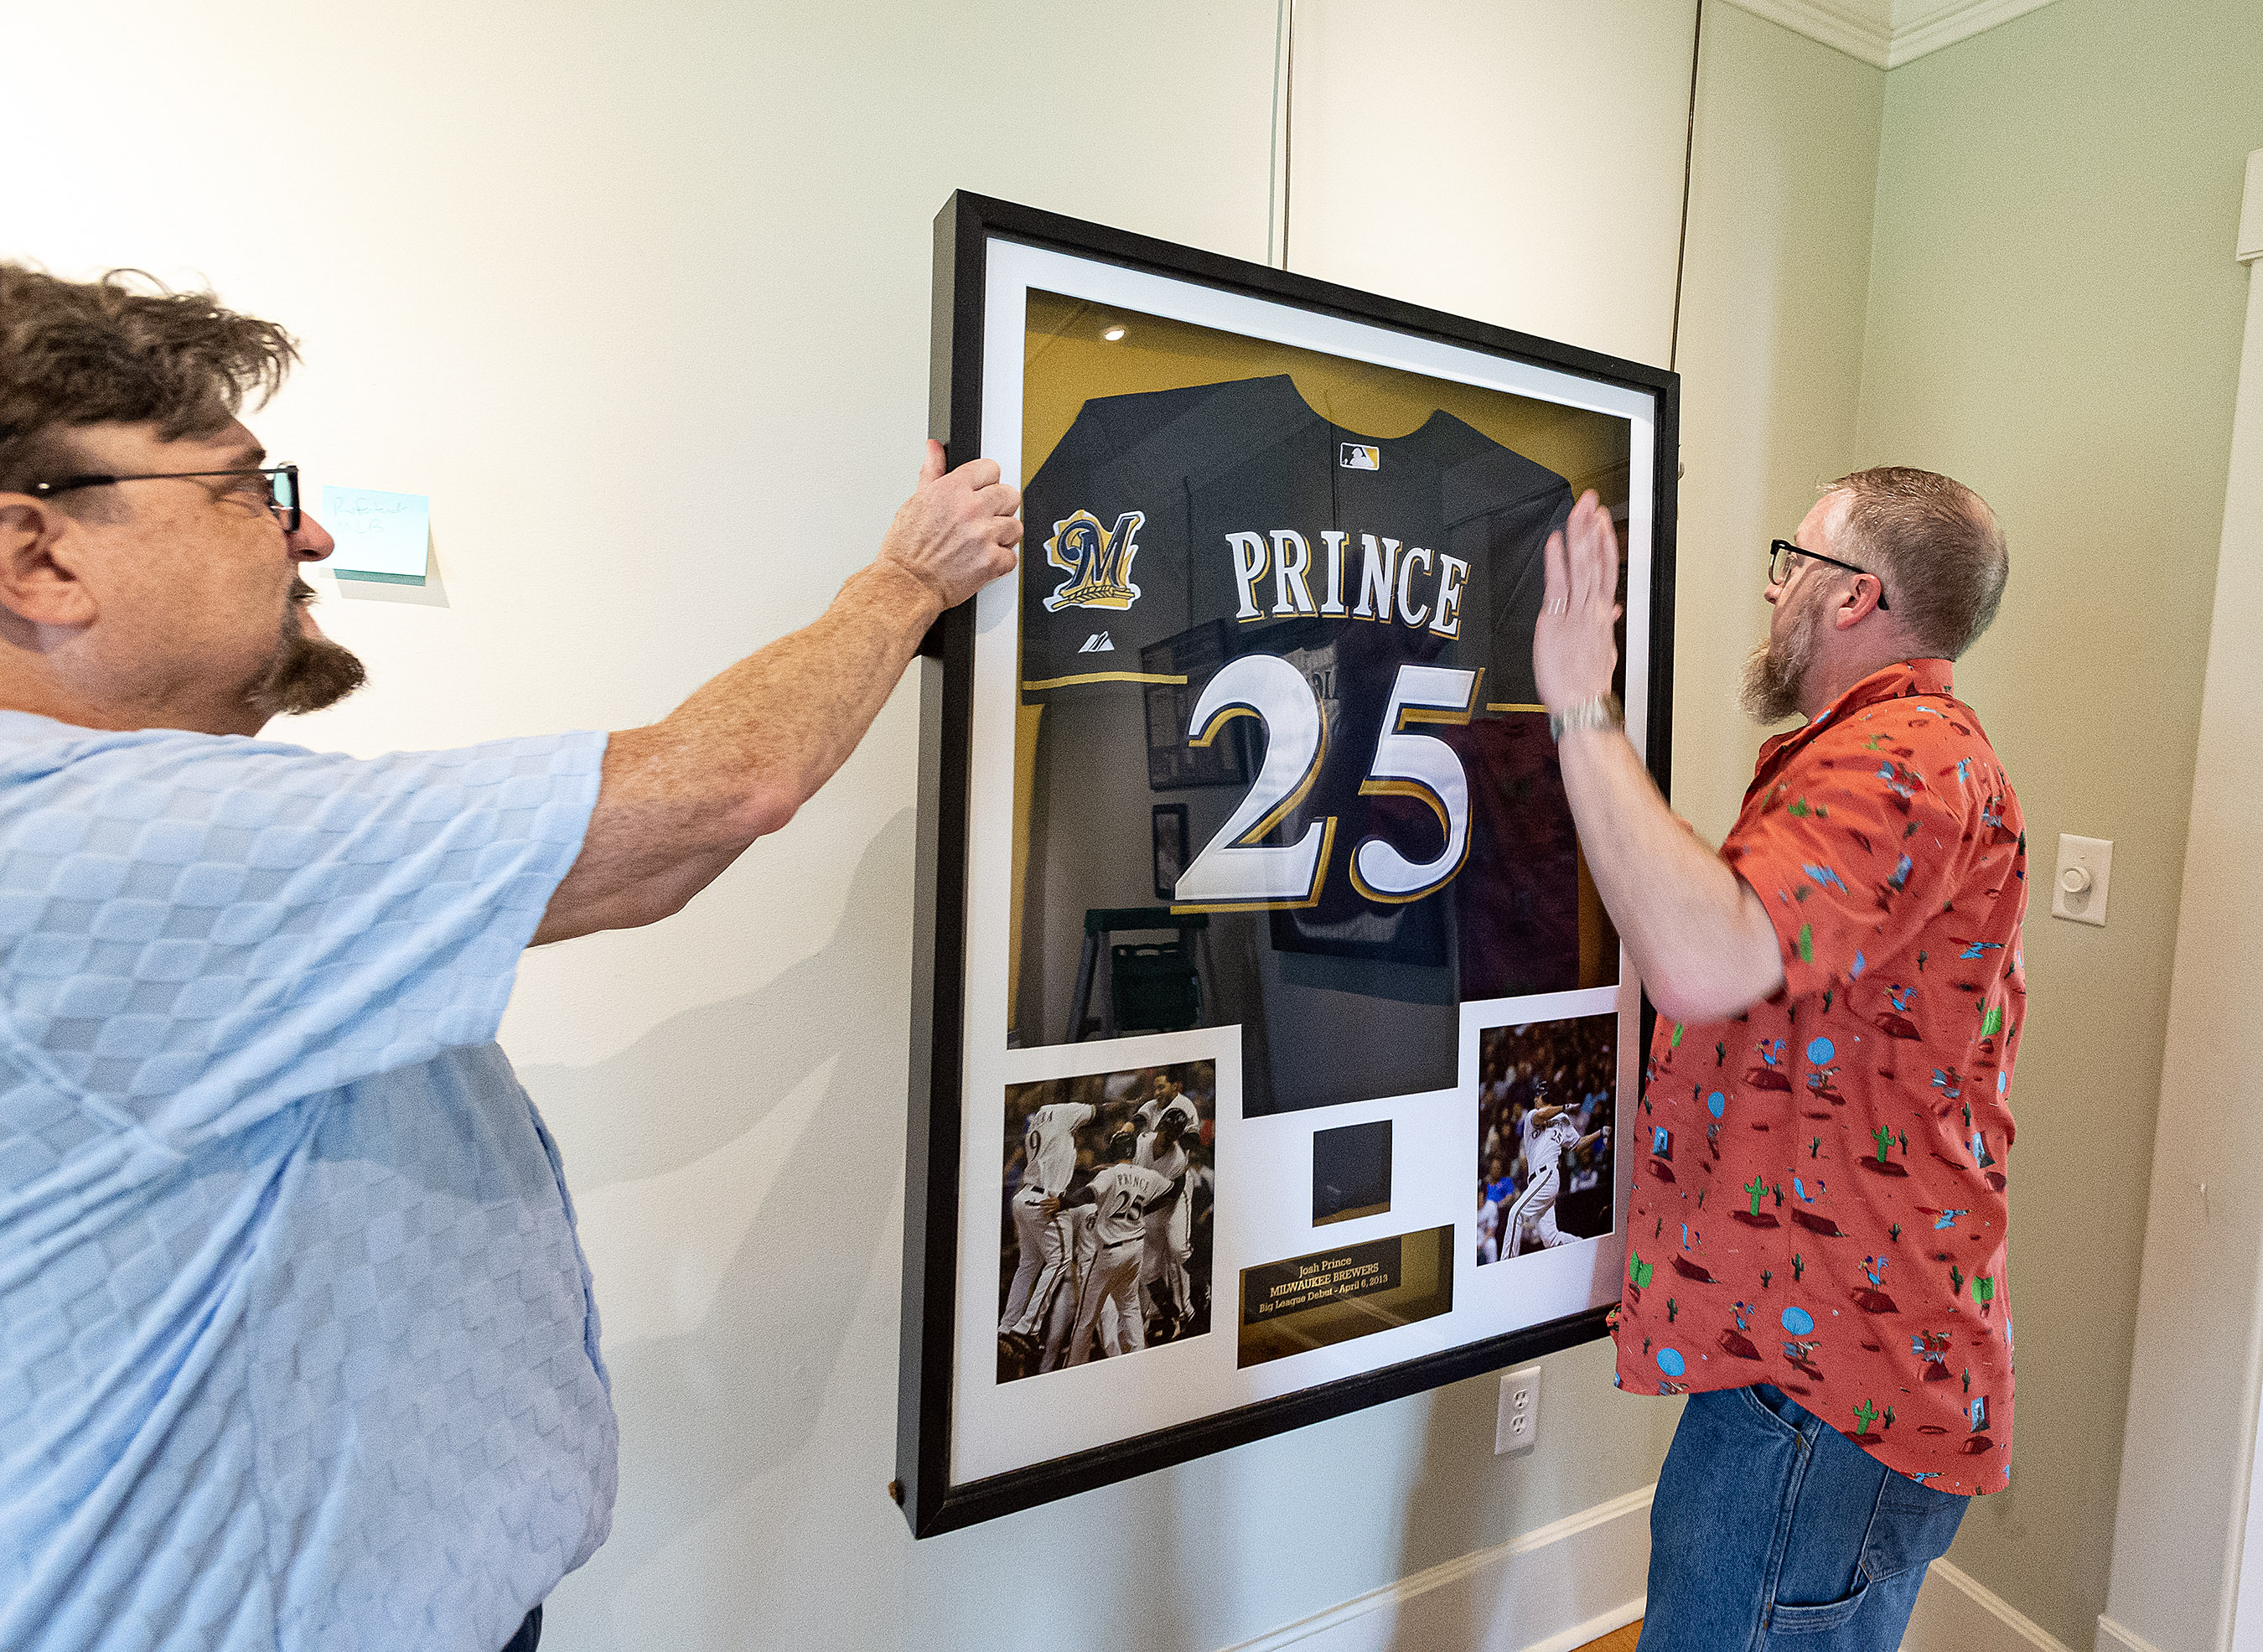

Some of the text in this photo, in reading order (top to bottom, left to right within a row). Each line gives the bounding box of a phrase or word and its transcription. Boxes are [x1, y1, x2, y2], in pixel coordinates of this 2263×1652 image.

[1225, 529, 1471, 640] PRINCE
[1170, 653, 1485, 914] 25
[1029, 1130, 1041, 1161] 9
[1109, 1190, 1145, 1221] 25
[1270, 1262, 1379, 1298] MILWAUKEE BREWERS
[1299, 1256, 1352, 1278] Josh Prince
[1259, 1302, 1273, 1313] Big
[1275, 1295, 1306, 1309] League
[1308, 1287, 1333, 1301] Debut
[1339, 1280, 1359, 1295] April
[1369, 1274, 1388, 1287] 2013
